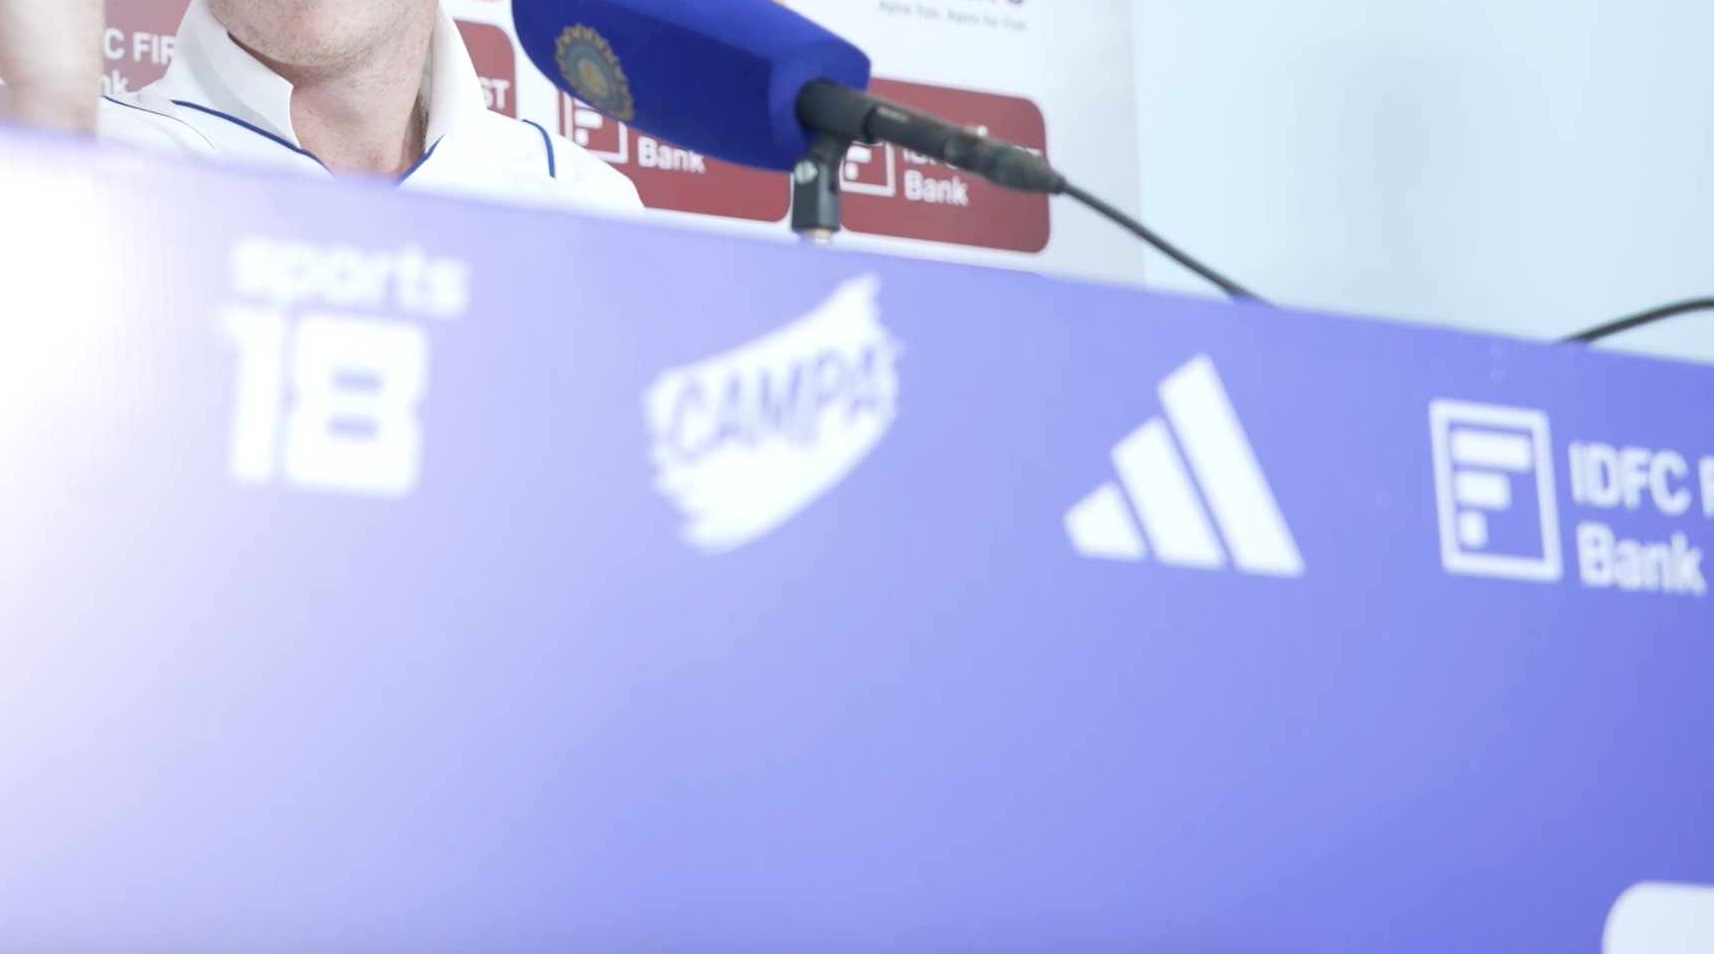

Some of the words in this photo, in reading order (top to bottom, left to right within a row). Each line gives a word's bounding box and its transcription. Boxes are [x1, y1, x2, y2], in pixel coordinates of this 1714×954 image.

[133, 31, 177, 65] FIR
[638, 136, 706, 174] Bank
[904, 169, 969, 207] Bank
[232, 236, 472, 319] sports
[220, 303, 429, 497] 18
[663, 342, 889, 460] CAMPA
[1568, 439, 1691, 516] IDFC
[1576, 520, 1708, 596] Bank
